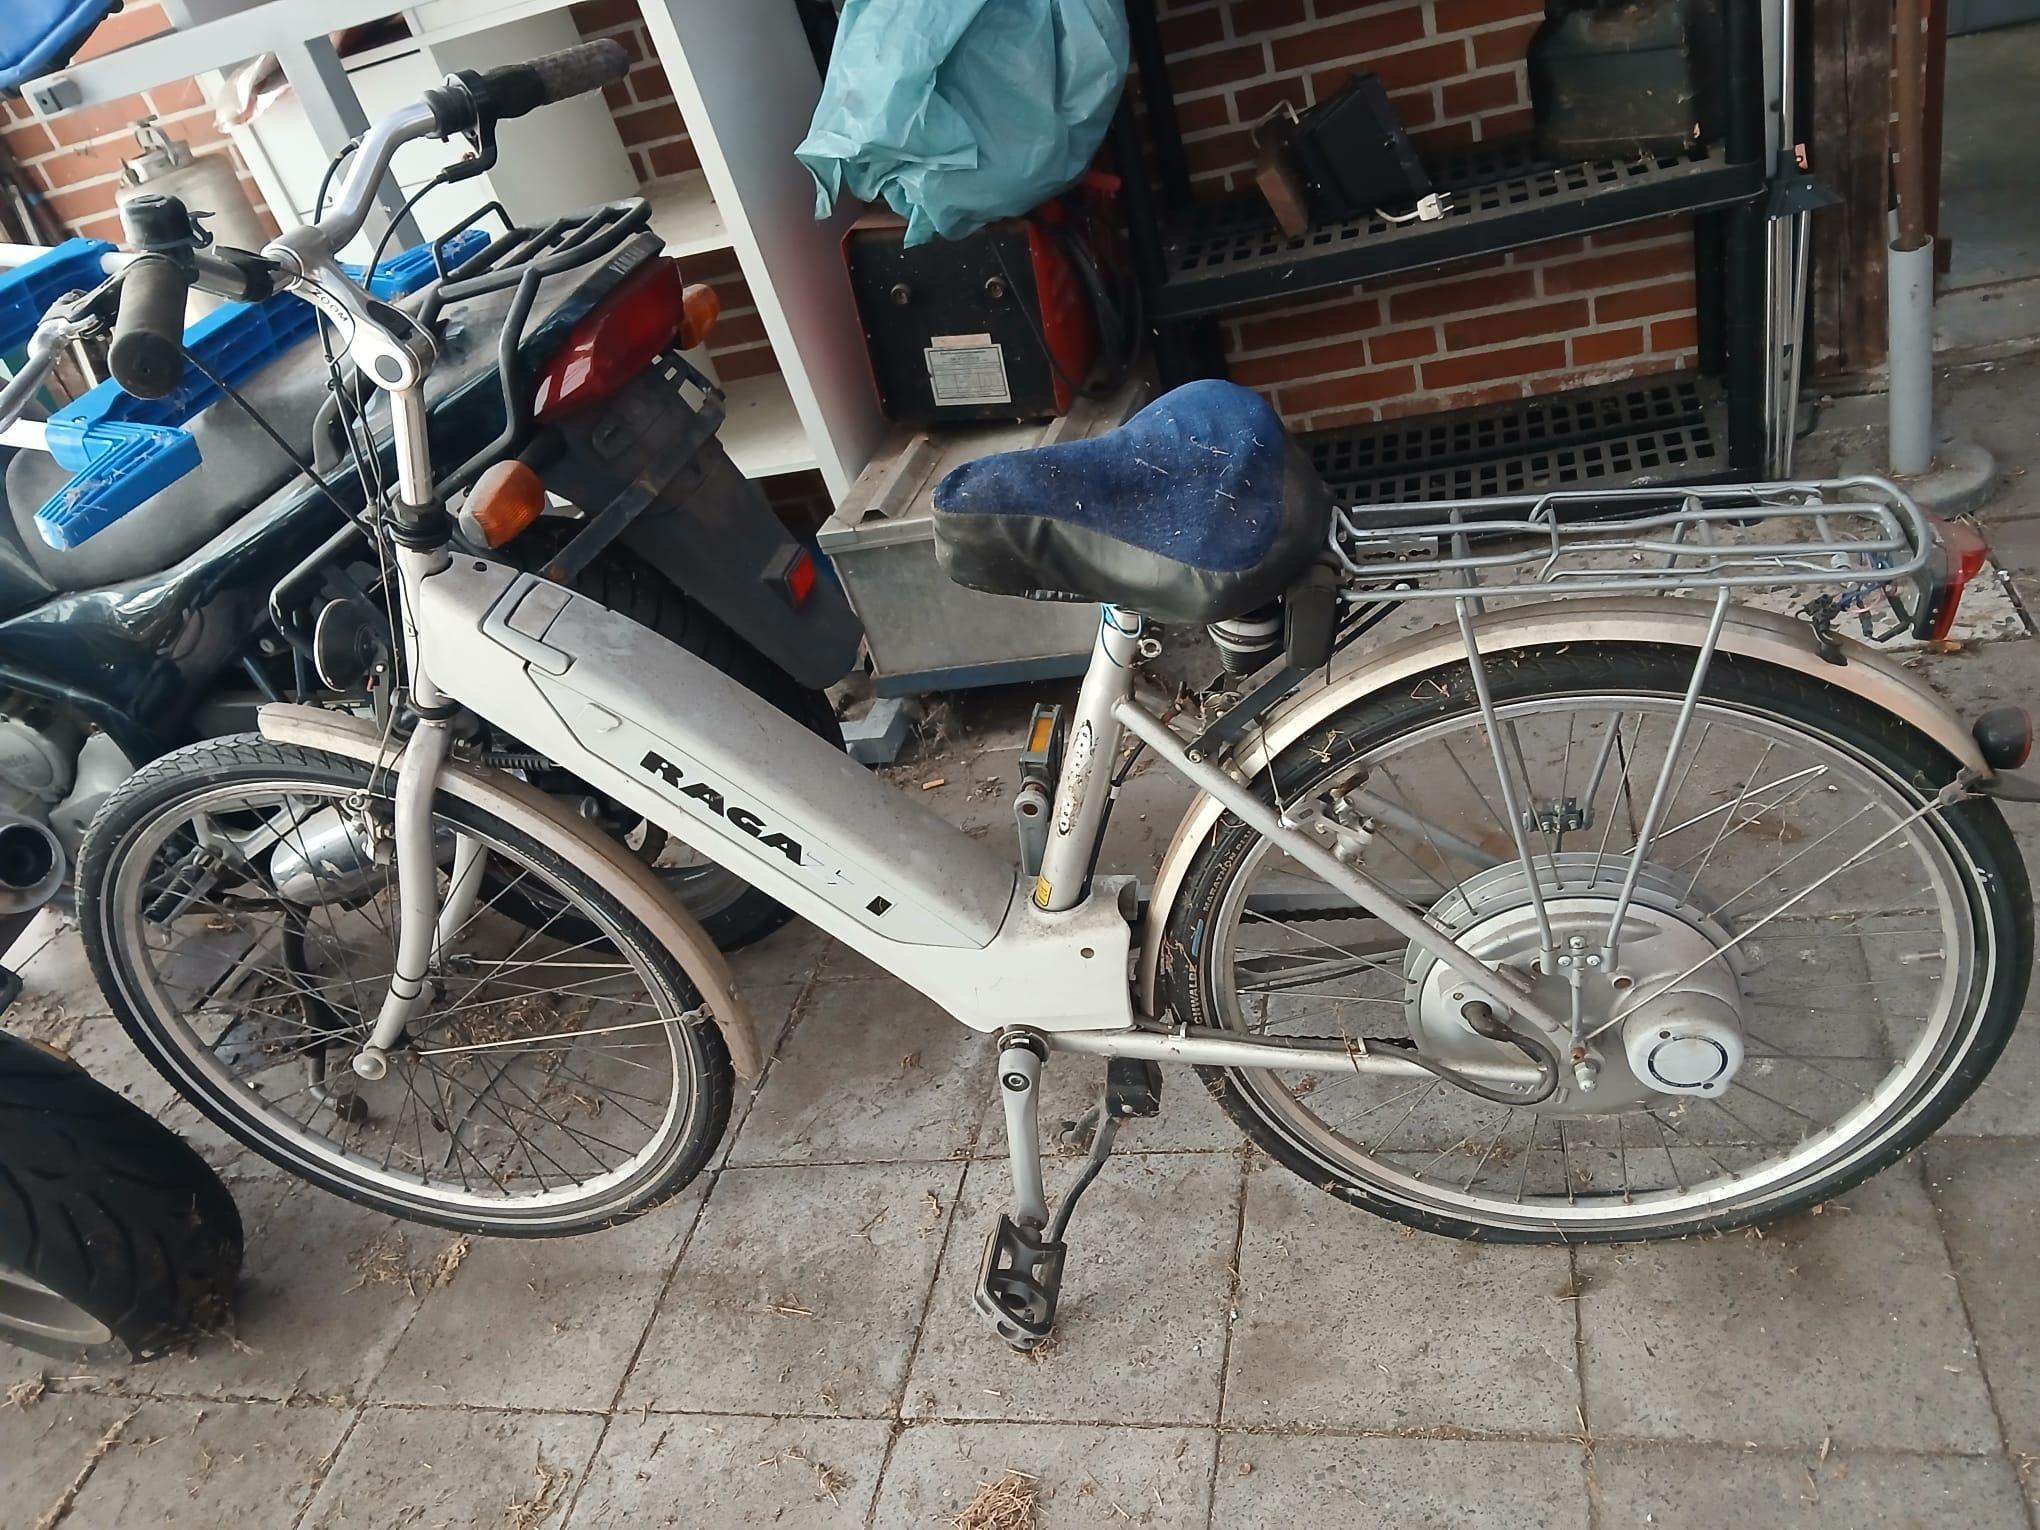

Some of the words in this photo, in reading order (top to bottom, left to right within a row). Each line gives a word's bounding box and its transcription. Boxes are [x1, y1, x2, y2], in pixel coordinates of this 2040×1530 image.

[312, 289, 348, 322] ZOOM
[640, 750, 802, 866] RAGA
[1188, 964, 1203, 1024] CHWALBE
[1203, 851, 1237, 912] MARATHON
